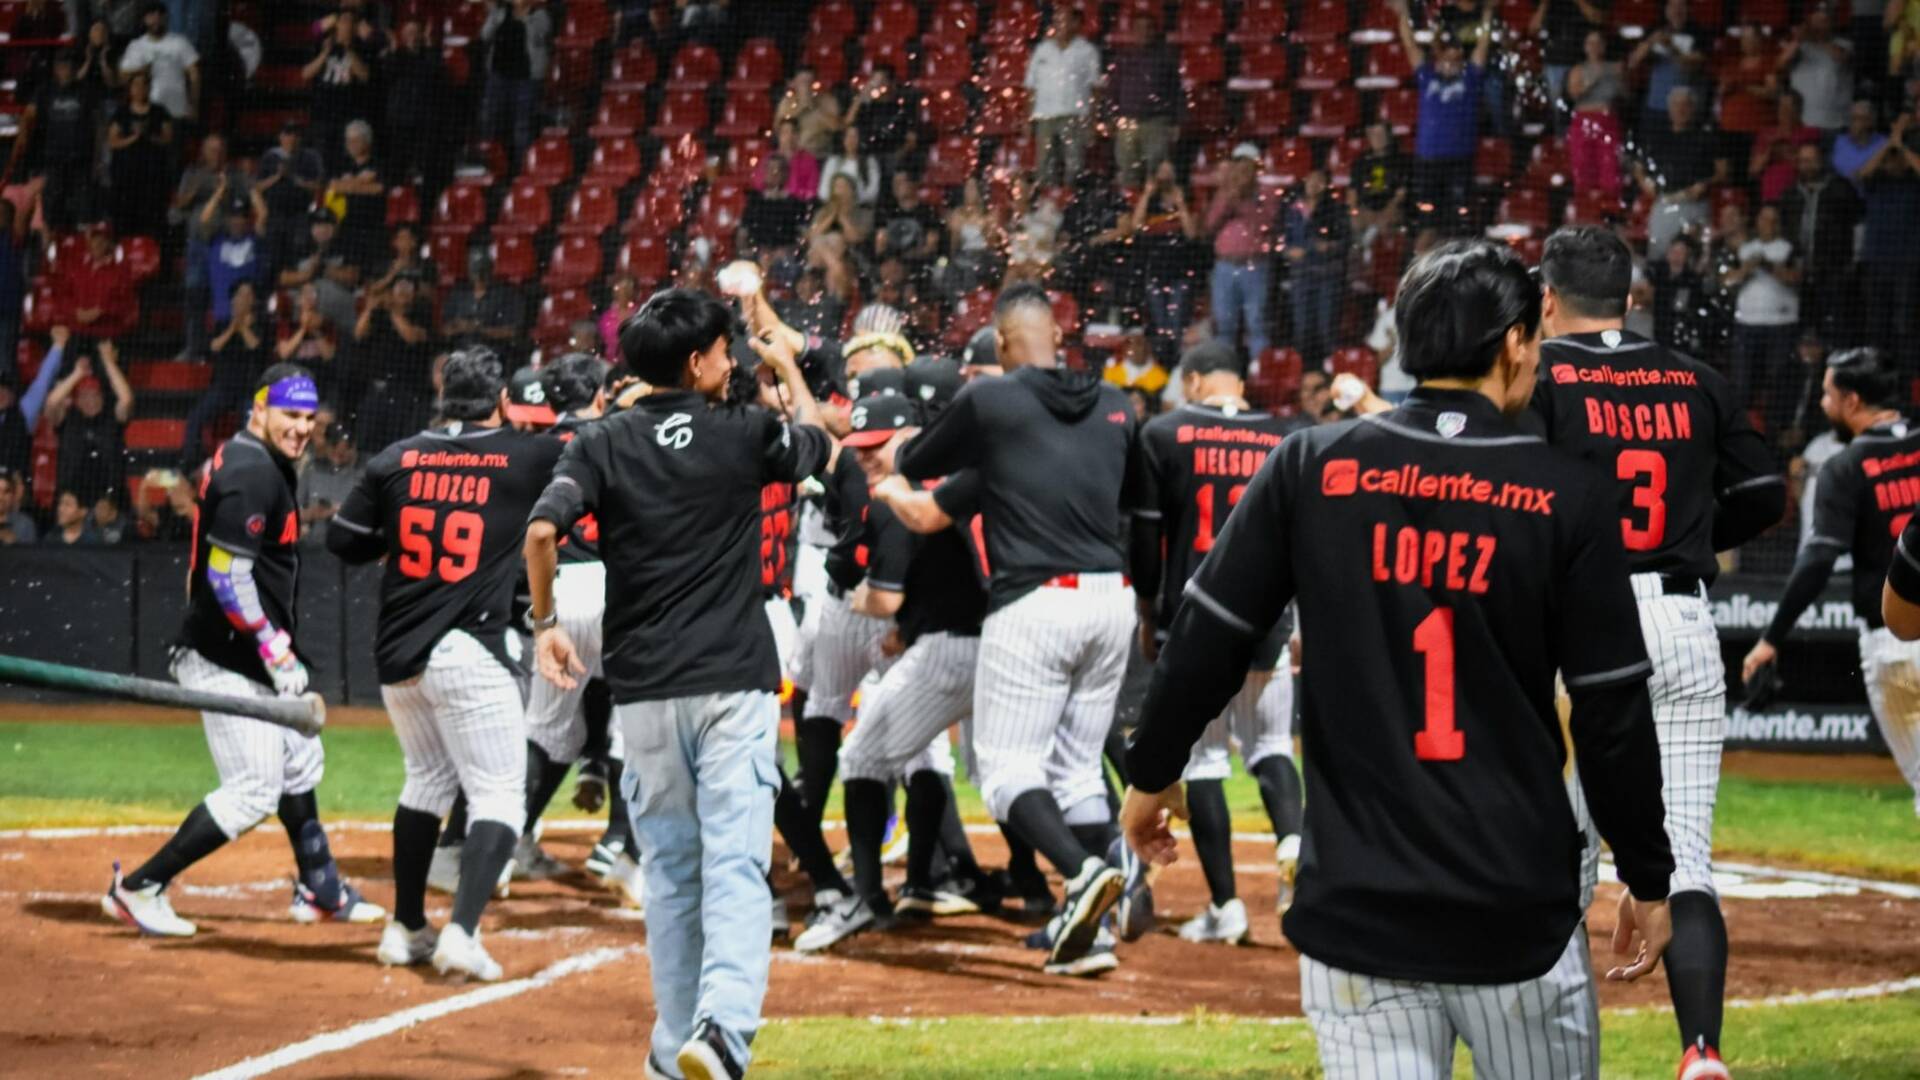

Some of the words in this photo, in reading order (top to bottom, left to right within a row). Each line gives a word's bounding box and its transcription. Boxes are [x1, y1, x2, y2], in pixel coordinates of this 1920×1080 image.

[1578, 364, 1697, 386] caliente.mx
[1585, 398, 1691, 440] BOSCAN
[417, 451, 508, 468] caliente.mx
[410, 471, 490, 505] OROZCO
[1360, 464, 1555, 515] caliente.mx
[1617, 449, 1666, 550] 3
[399, 506, 485, 583] 59
[1373, 523, 1496, 593] LOPEZ
[1413, 607, 1465, 760] 1
